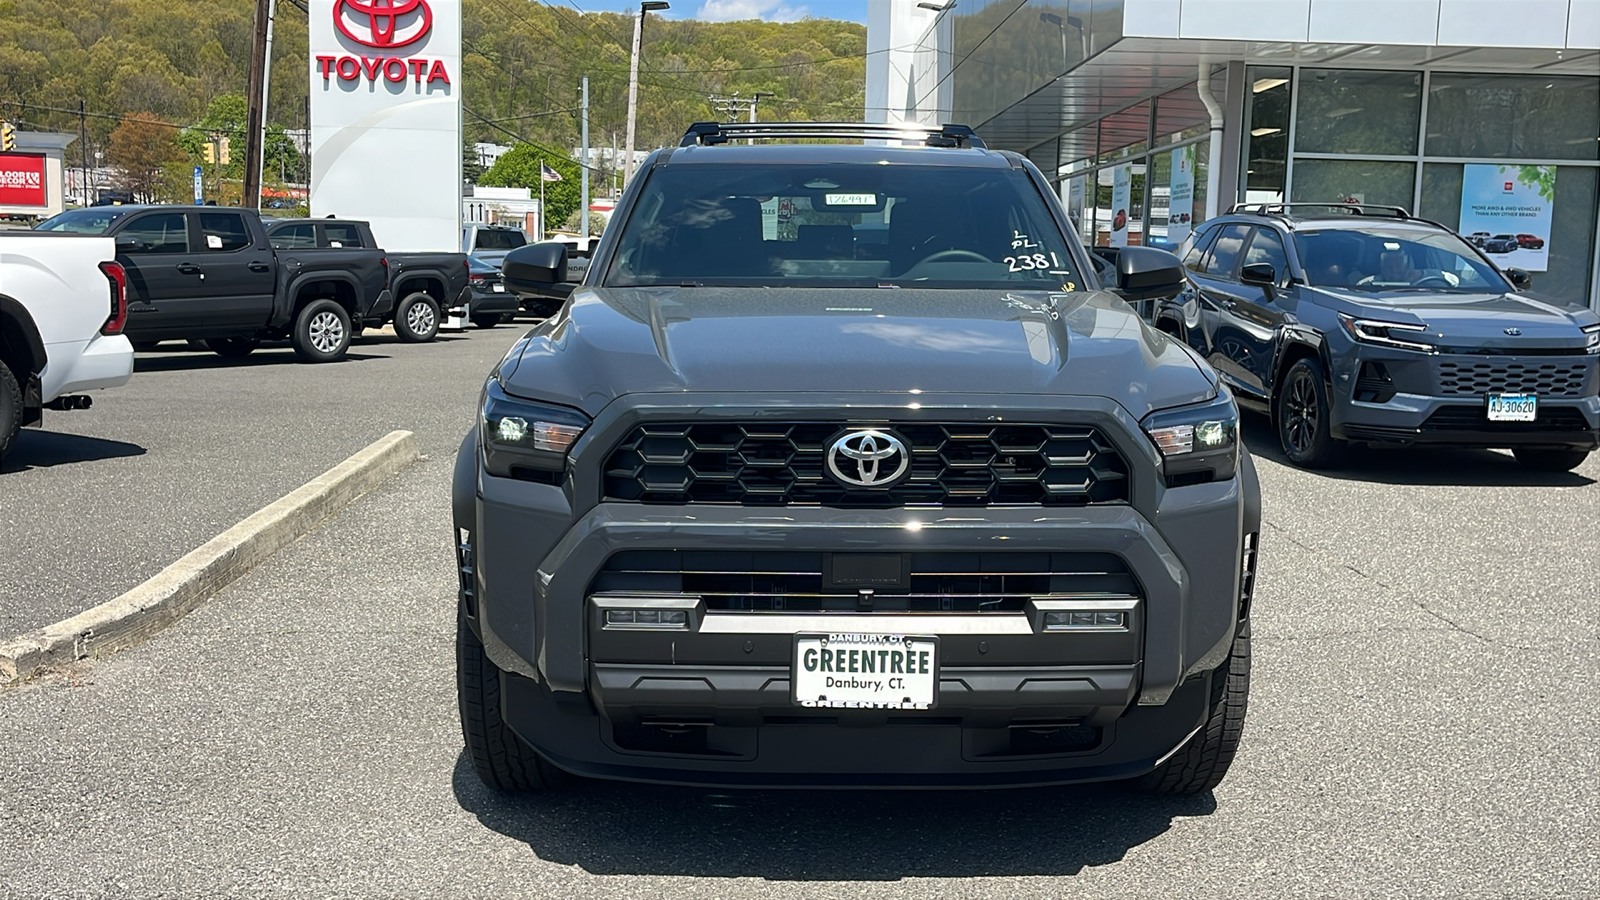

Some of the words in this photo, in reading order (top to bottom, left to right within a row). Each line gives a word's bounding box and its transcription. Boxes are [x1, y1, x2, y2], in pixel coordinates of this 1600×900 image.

[316, 56, 450, 84] TOYOTA
[1003, 252, 1059, 272] 2381
[888, 634, 905, 643] CT
[803, 648, 929, 674] GREENTREE
[826, 676, 884, 692] Danbury,
[888, 678, 905, 690] CT.
[801, 700, 929, 710] GREENTREE
